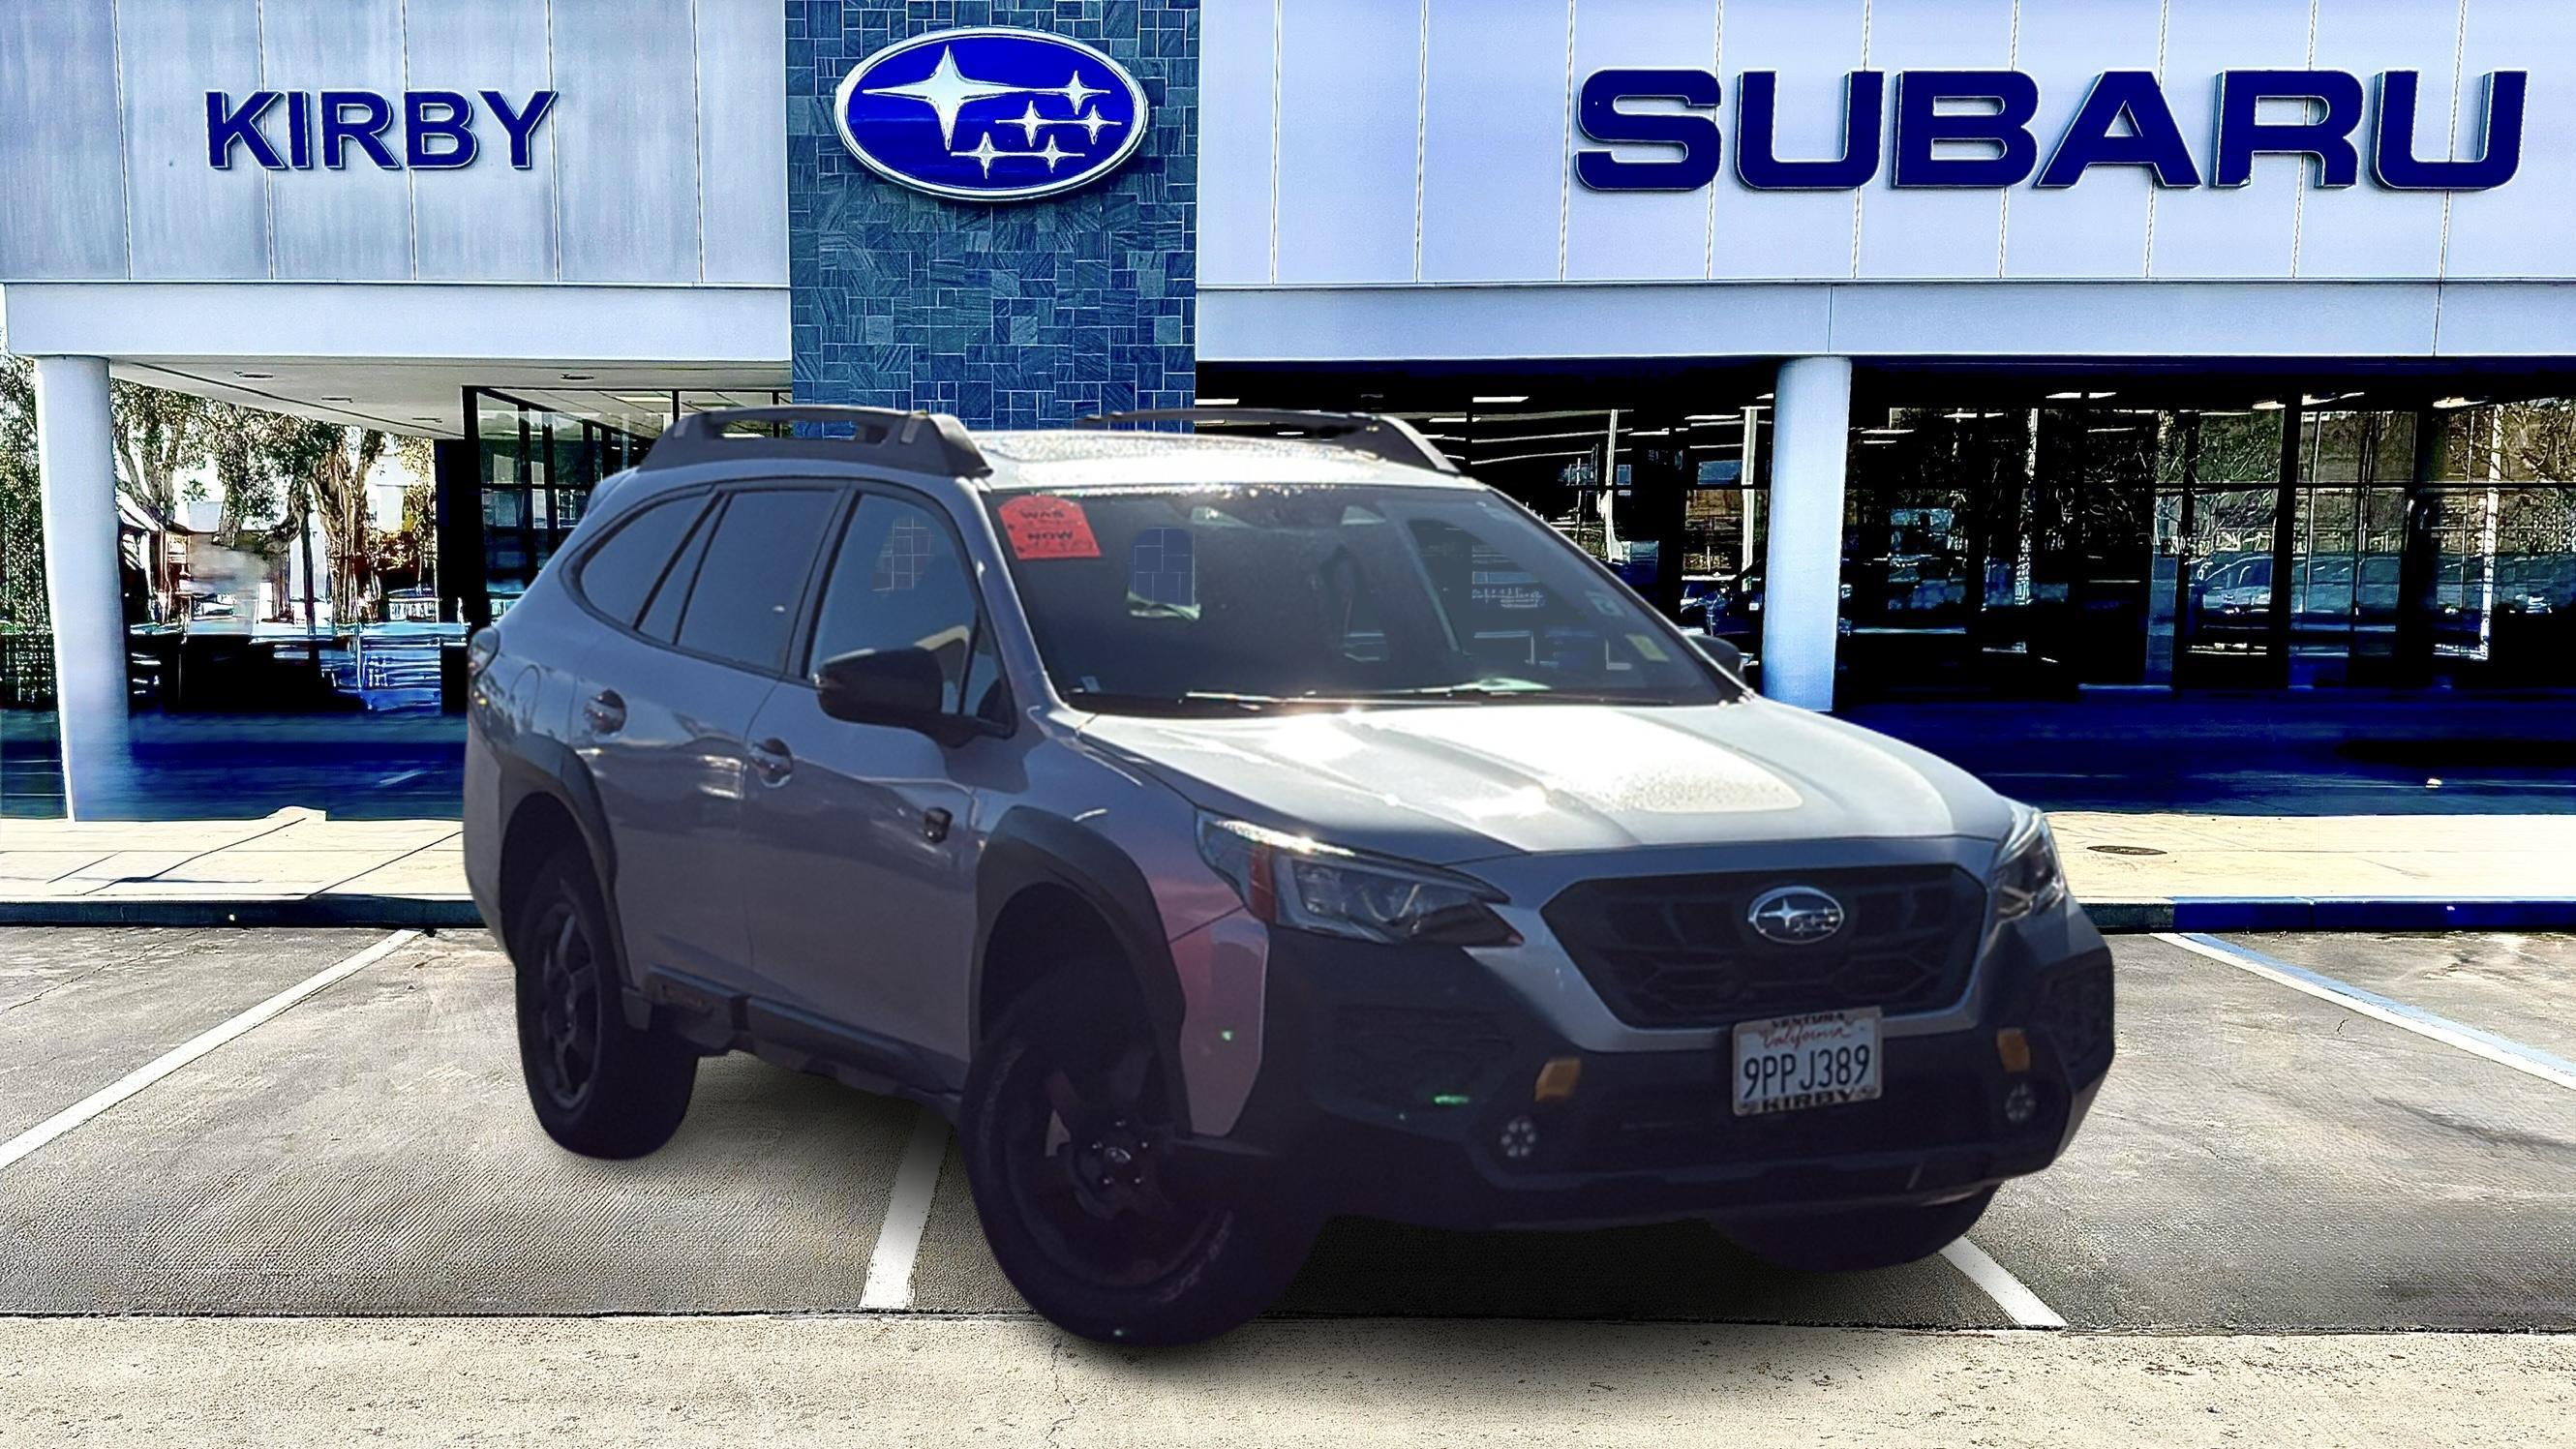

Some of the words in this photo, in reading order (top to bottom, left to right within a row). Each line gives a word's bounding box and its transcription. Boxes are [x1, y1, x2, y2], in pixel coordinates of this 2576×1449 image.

[204, 89, 559, 170] KIRBY
[1574, 69, 2528, 191] SUBARU
[1759, 1024, 1851, 1049] California
[1743, 1043, 1870, 1100] 9PPJ389
[1764, 1088, 1855, 1110] KIRBY
